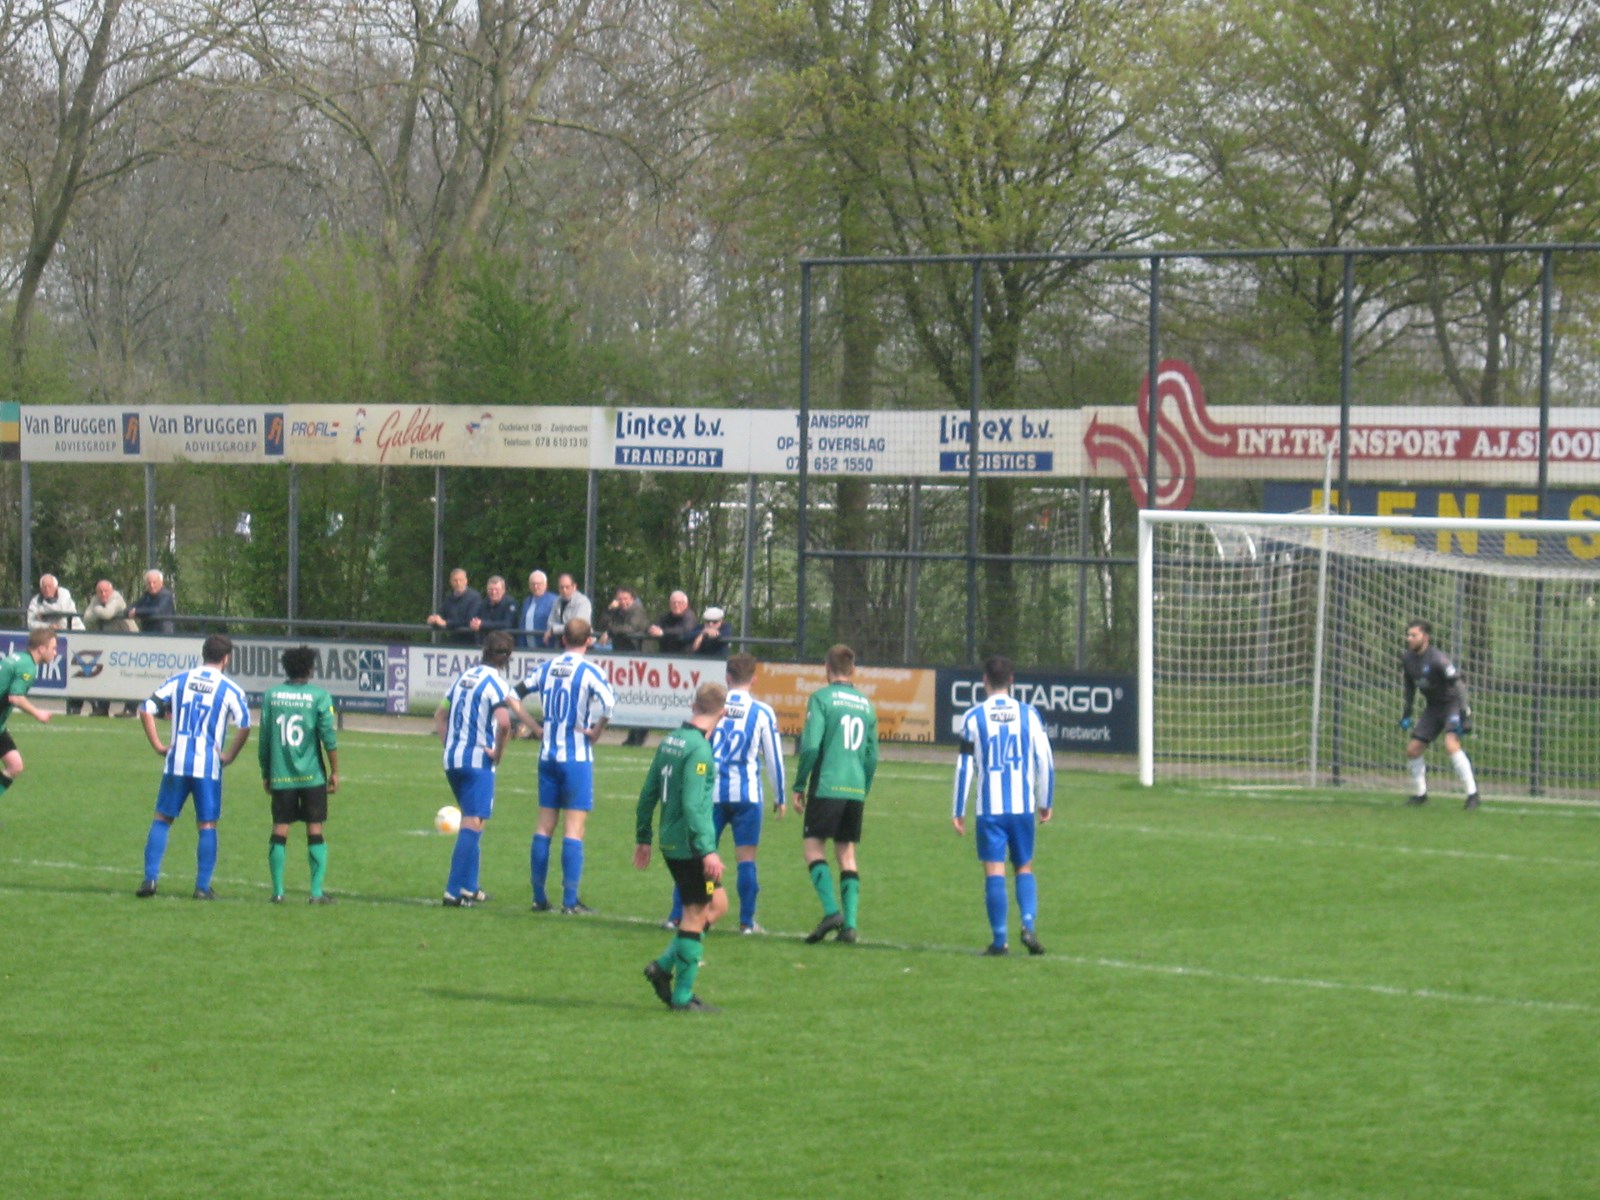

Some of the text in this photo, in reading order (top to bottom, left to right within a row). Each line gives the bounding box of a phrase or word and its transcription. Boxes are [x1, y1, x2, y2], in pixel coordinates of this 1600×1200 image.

[25, 415, 116, 434] Van Bruggen
[149, 415, 257, 434] Van Bruggen
[694, 412, 724, 437] b.v.
[795, 414, 870, 428] TANSPORT
[1022, 415, 1054, 439] b.v.
[376, 407, 444, 462] Gulden
[535, 437, 550, 447] 078
[55, 441, 117, 452] ADVIESGROEP
[185, 441, 257, 452] ADVIESGROEP
[410, 448, 445, 460] Fietsen
[818, 437, 886, 452] OVERSLAG
[622, 449, 717, 465] TRANSPORT
[814, 456, 838, 471] 652
[843, 457, 874, 472] 1550
[543, 687, 570, 724] 10
[952, 681, 1113, 714] COTARGO
[178, 701, 212, 738] 17
[276, 714, 304, 747] 16
[840, 714, 865, 751] 10
[1062, 725, 1112, 742] network
[988, 733, 1022, 771] 14
